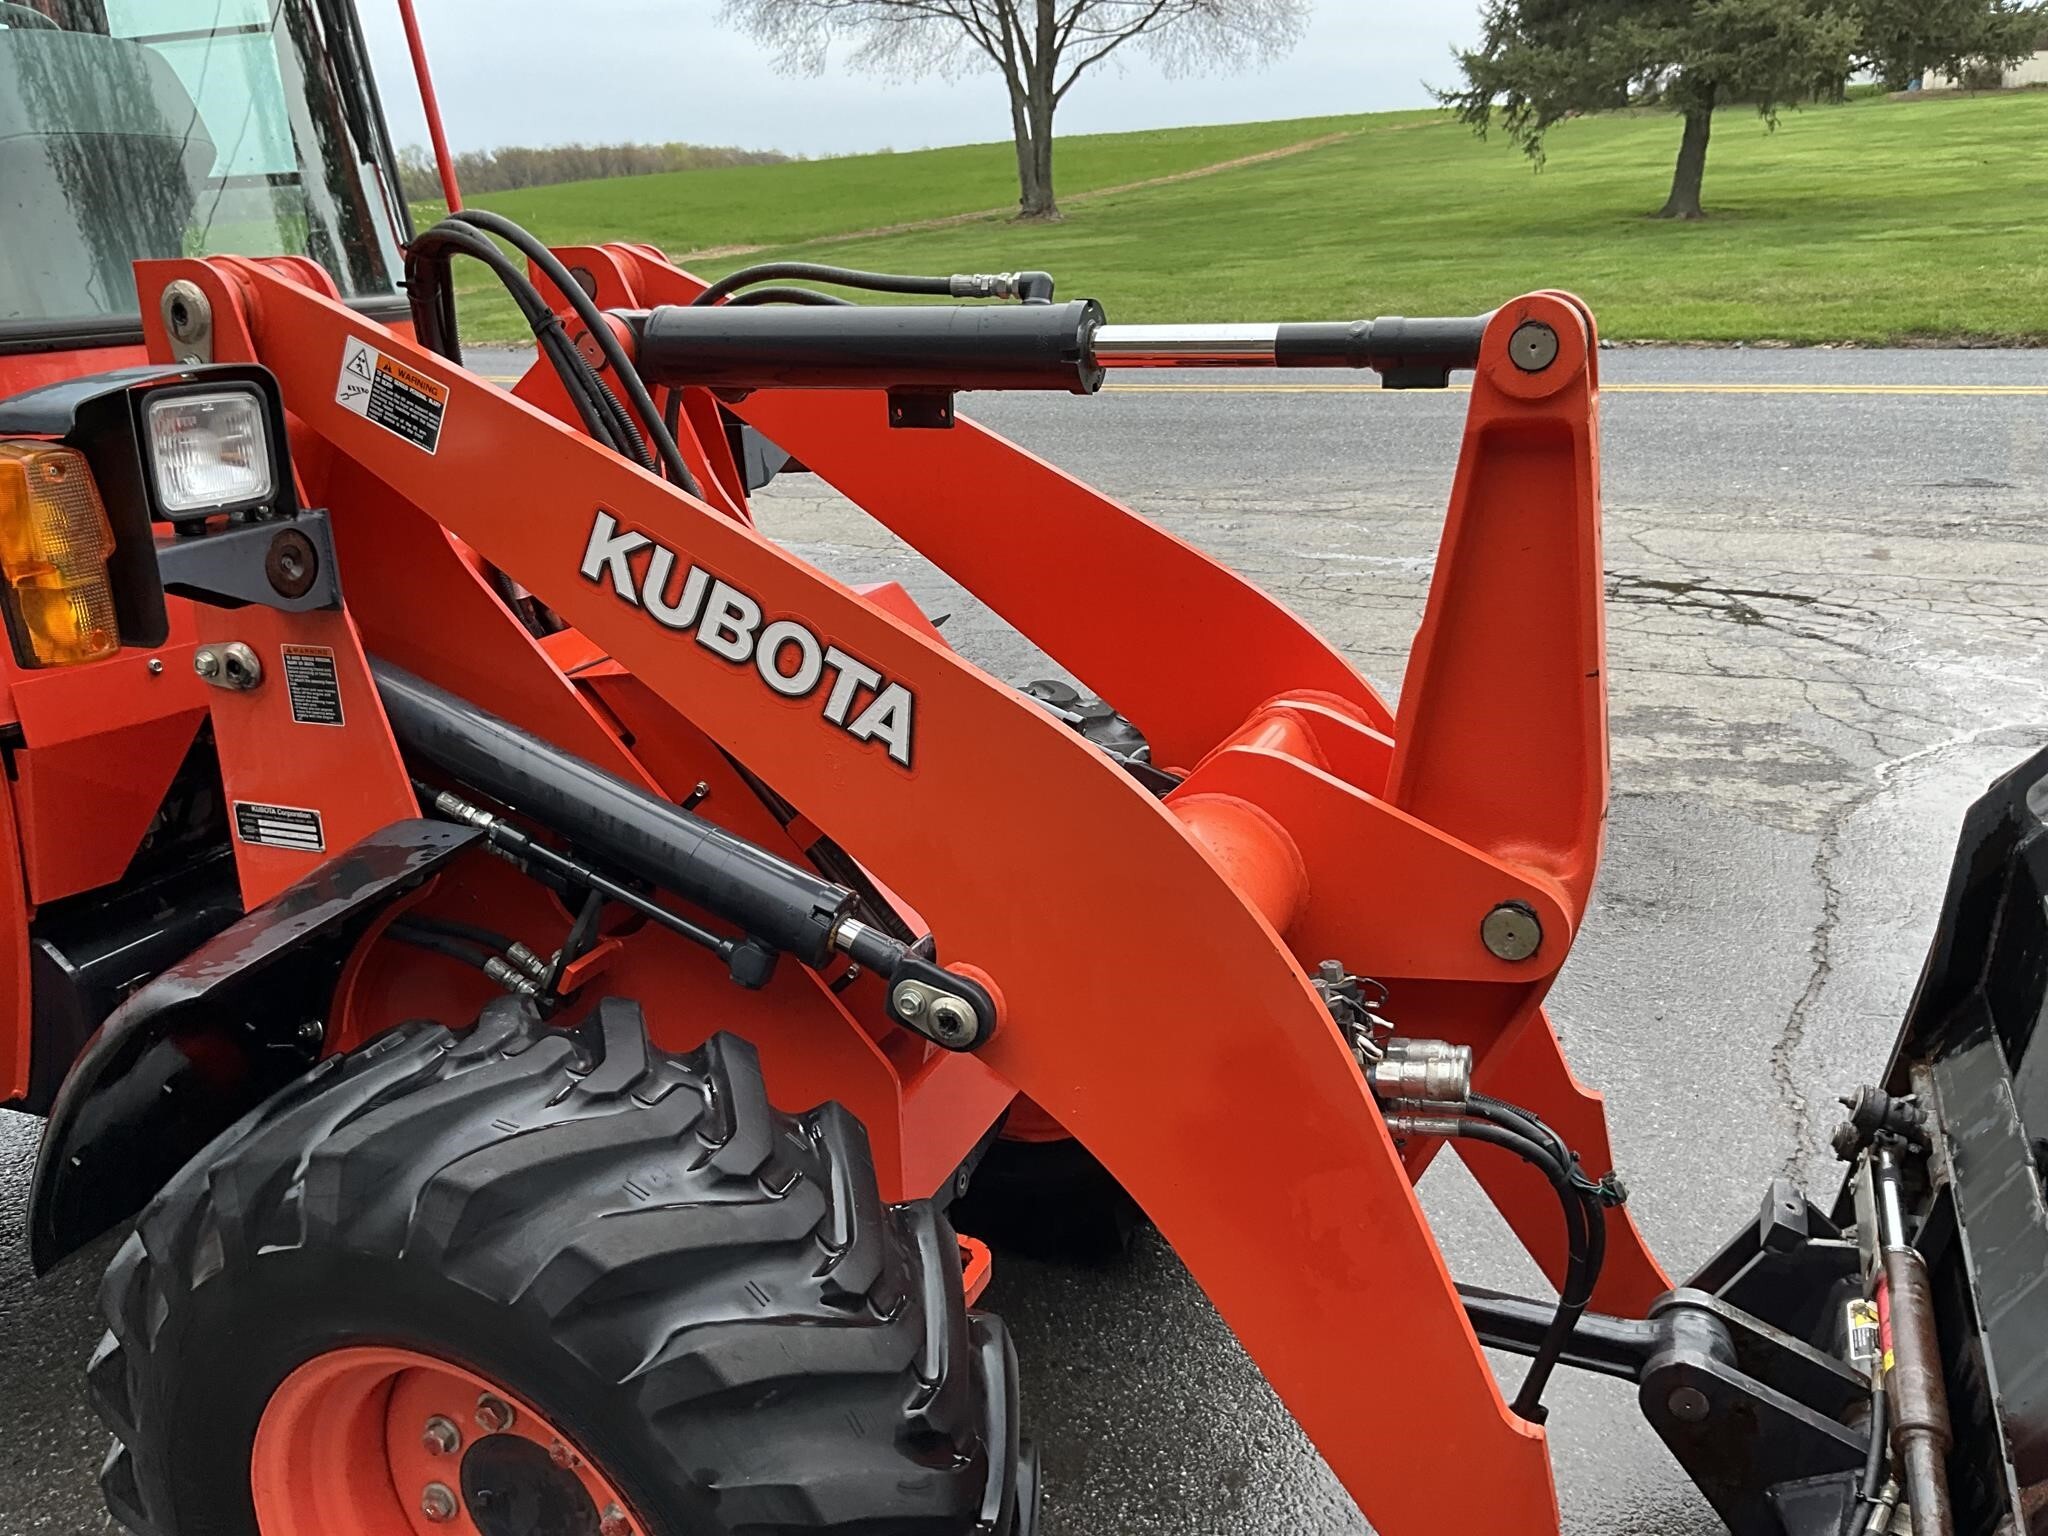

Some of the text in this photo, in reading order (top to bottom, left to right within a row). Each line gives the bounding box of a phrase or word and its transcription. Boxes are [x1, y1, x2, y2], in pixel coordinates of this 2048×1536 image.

[397, 368, 438, 396] WARNING
[580, 510, 912, 767] KUBOTA
[250, 806, 276, 814] KUBOTA
[276, 809, 311, 818] Corporation
